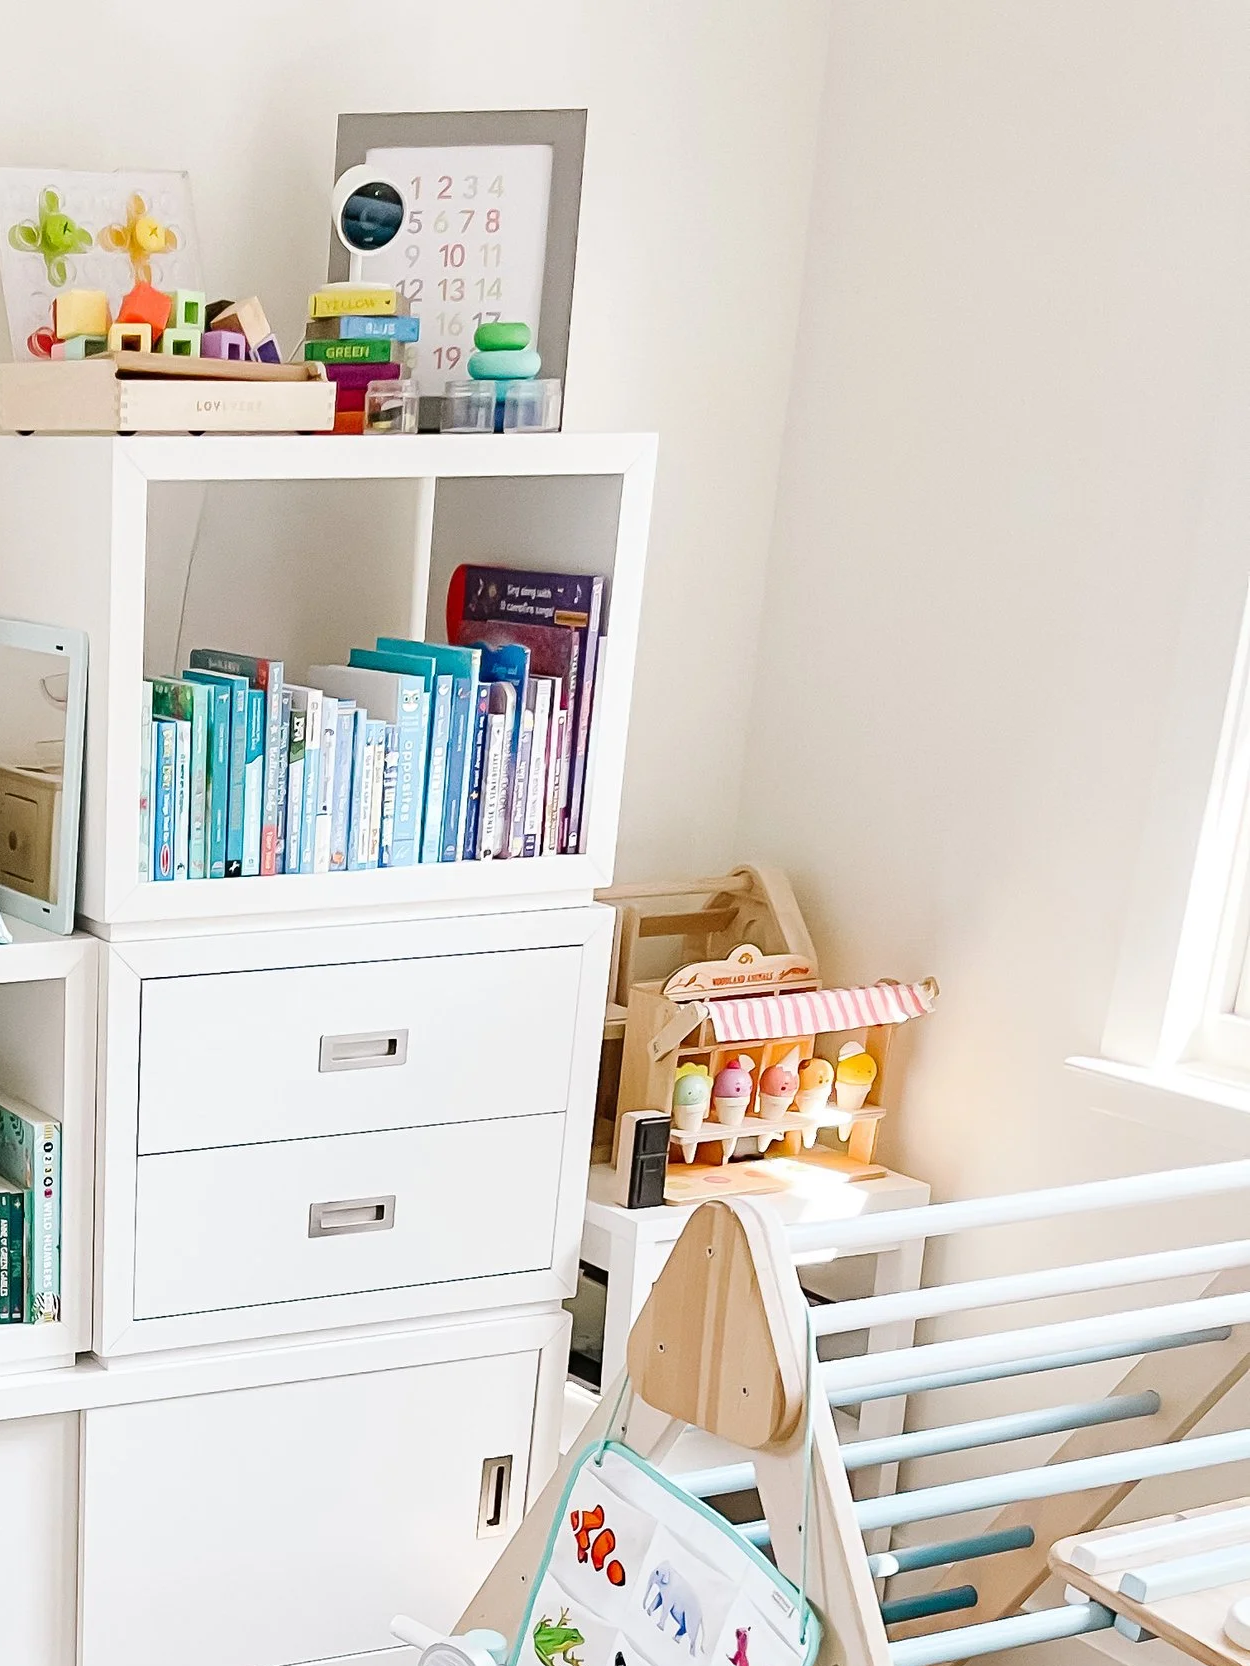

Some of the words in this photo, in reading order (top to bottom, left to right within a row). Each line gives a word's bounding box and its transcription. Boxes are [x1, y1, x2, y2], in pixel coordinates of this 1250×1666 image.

[410, 176, 422, 200] 1
[437, 175, 453, 200] 2
[462, 175, 479, 200] 3
[487, 175, 505, 199] 4
[406, 210, 423, 234] 5
[433, 210, 449, 234] 6
[459, 209, 476, 234] 7
[485, 209, 501, 233] 8
[404, 244, 420, 269] 9
[438, 243, 466, 268] 10
[479, 243, 502, 268] 11
[395, 278, 424, 303] 12
[437, 278, 465, 303] 13
[474, 277, 503, 302] 14
[365, 322, 396, 335] BLUE
[435, 311, 464, 337] 16
[325, 345, 370, 359] GREEN
[433, 346, 462, 370] 19
[399, 740, 414, 823] opposites
[43, 1234, 54, 1288] NUMBERS
